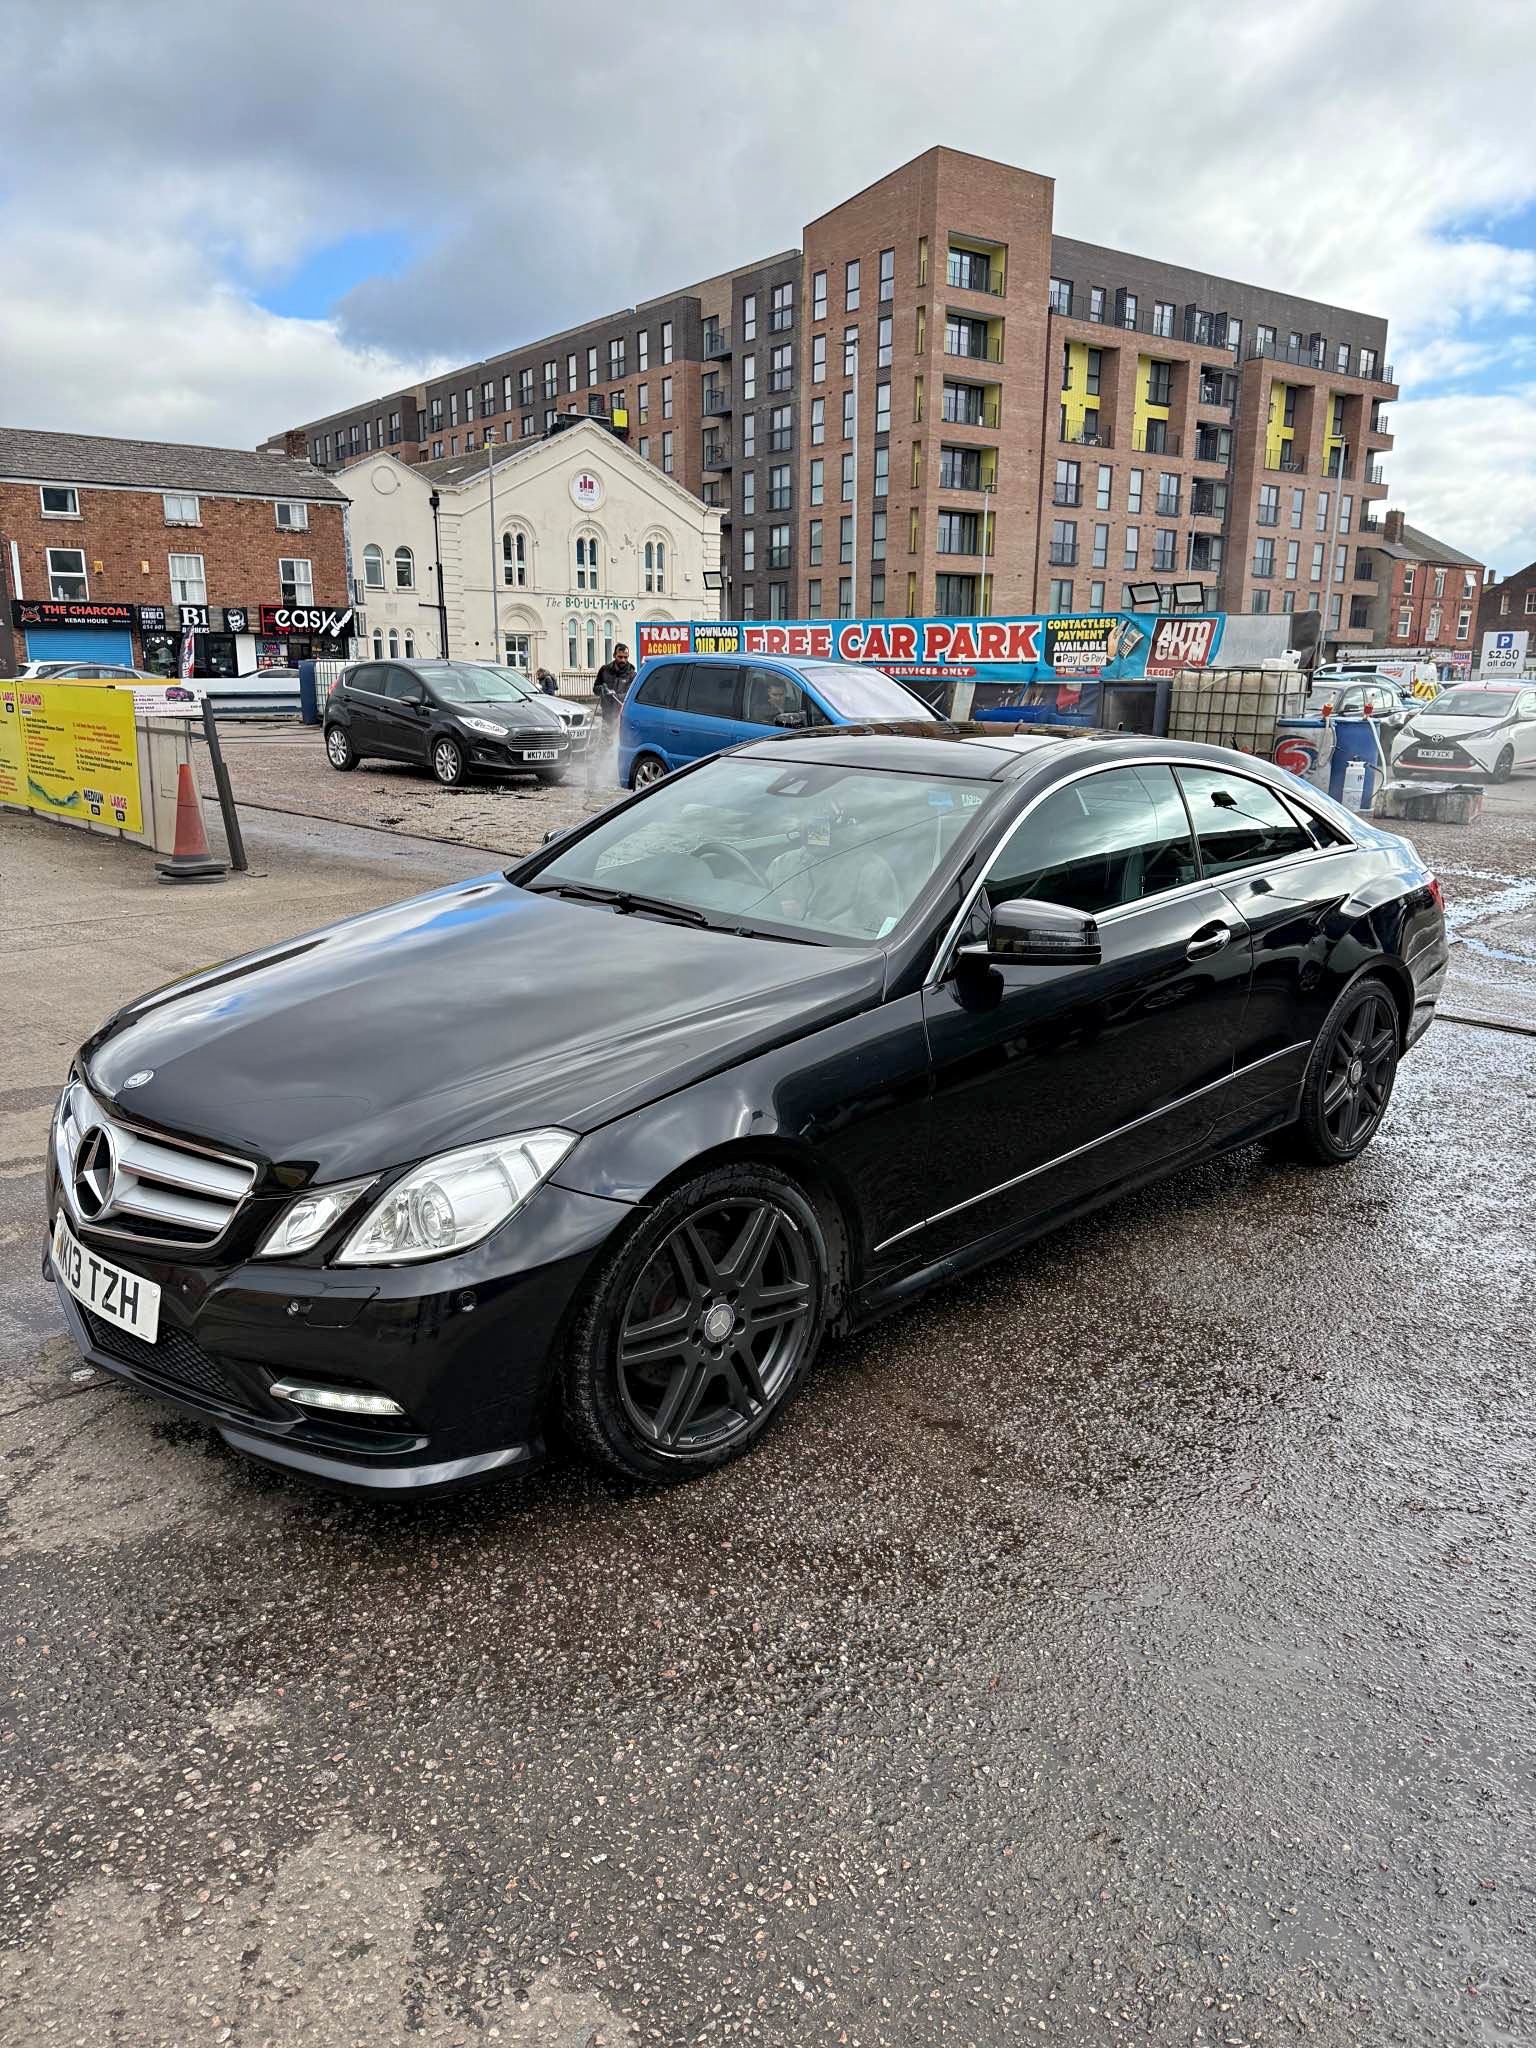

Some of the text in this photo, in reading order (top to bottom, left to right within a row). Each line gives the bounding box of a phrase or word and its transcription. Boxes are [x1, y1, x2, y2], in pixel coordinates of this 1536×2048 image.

[546, 597, 561, 608] The
[42, 605, 130, 616] THE CHARCOAL
[180, 607, 209, 626] B1
[275, 609, 336, 634] easy
[1047, 618, 1117, 630] CONTACTLESS
[640, 627, 689, 641] TRADE
[694, 627, 738, 638] DOWNLOAD
[1057, 630, 1104, 640] PAYMENT
[1157, 621, 1211, 643] AUTO
[696, 638, 738, 653] OUR APP
[743, 621, 1042, 662] FREE CAR PARK
[1500, 635, 1510, 646] P
[648, 643, 682, 654] ACCOUNT
[1053, 641, 1107, 652] AVAILABLE
[1154, 641, 1206, 661] GLYM
[1062, 653, 1078, 664] Pay
[1082, 653, 1105, 664] G Pay
[1488, 649, 1520, 660] £2.50
[1500, 660, 1517, 668] day
[889, 667, 938, 675] SERVICES
[941, 667, 969, 675] ONLY
[83, 788, 104, 804] MEDIUM
[110, 794, 128, 810] LARGE
[88, 1256, 140, 1325] TZH
